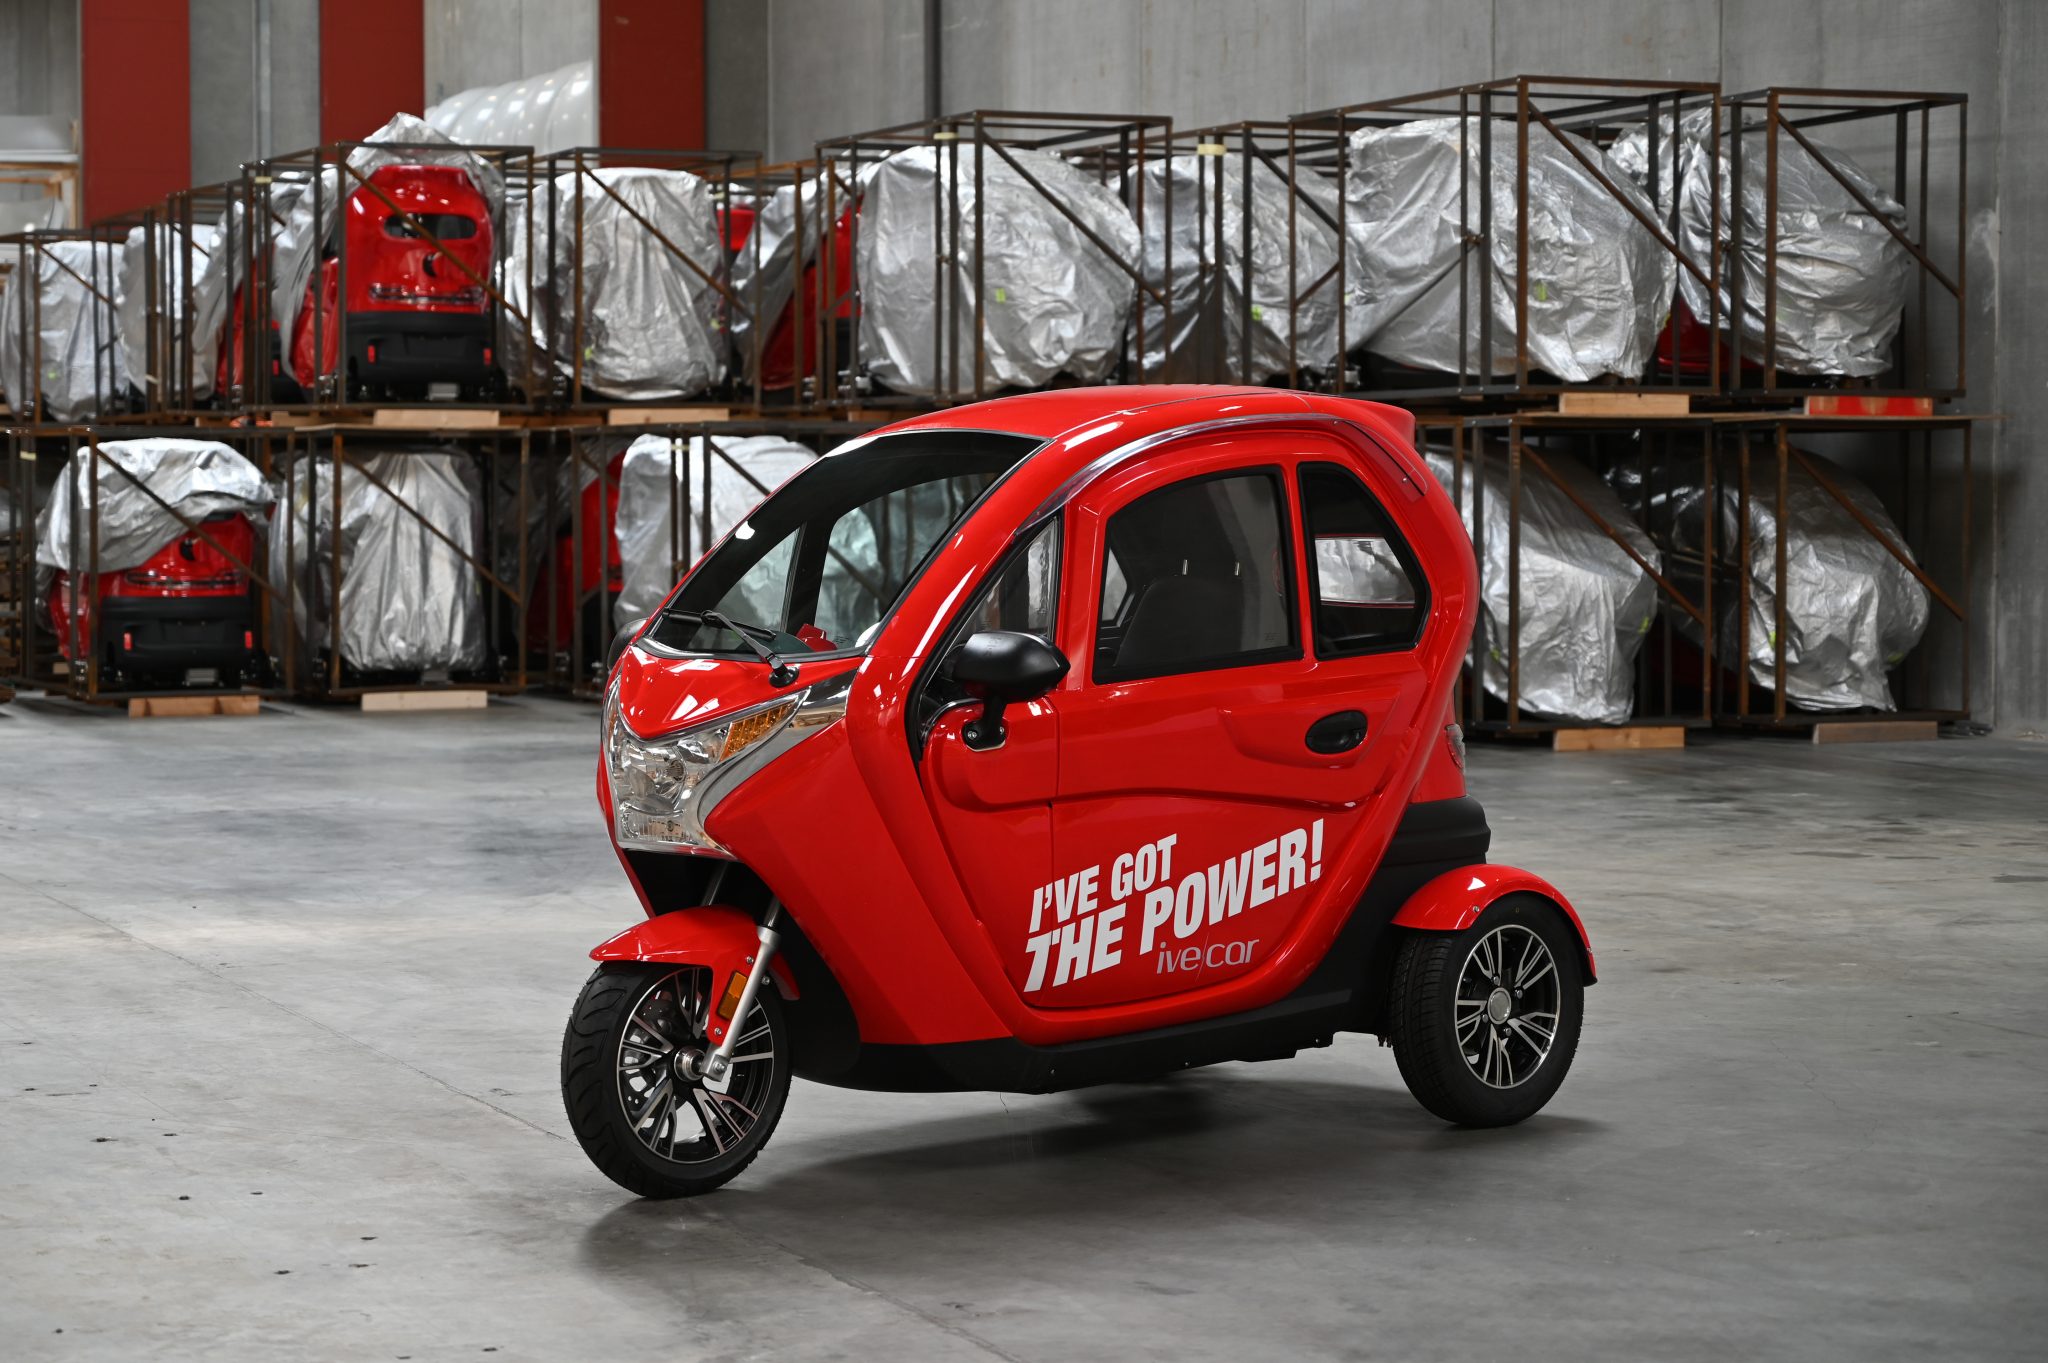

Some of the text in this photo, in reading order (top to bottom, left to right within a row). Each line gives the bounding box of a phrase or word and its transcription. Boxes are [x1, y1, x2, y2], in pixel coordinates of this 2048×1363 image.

[1023, 818, 1324, 992] THE POWER!
[1029, 833, 1177, 933] I'VE GOT
